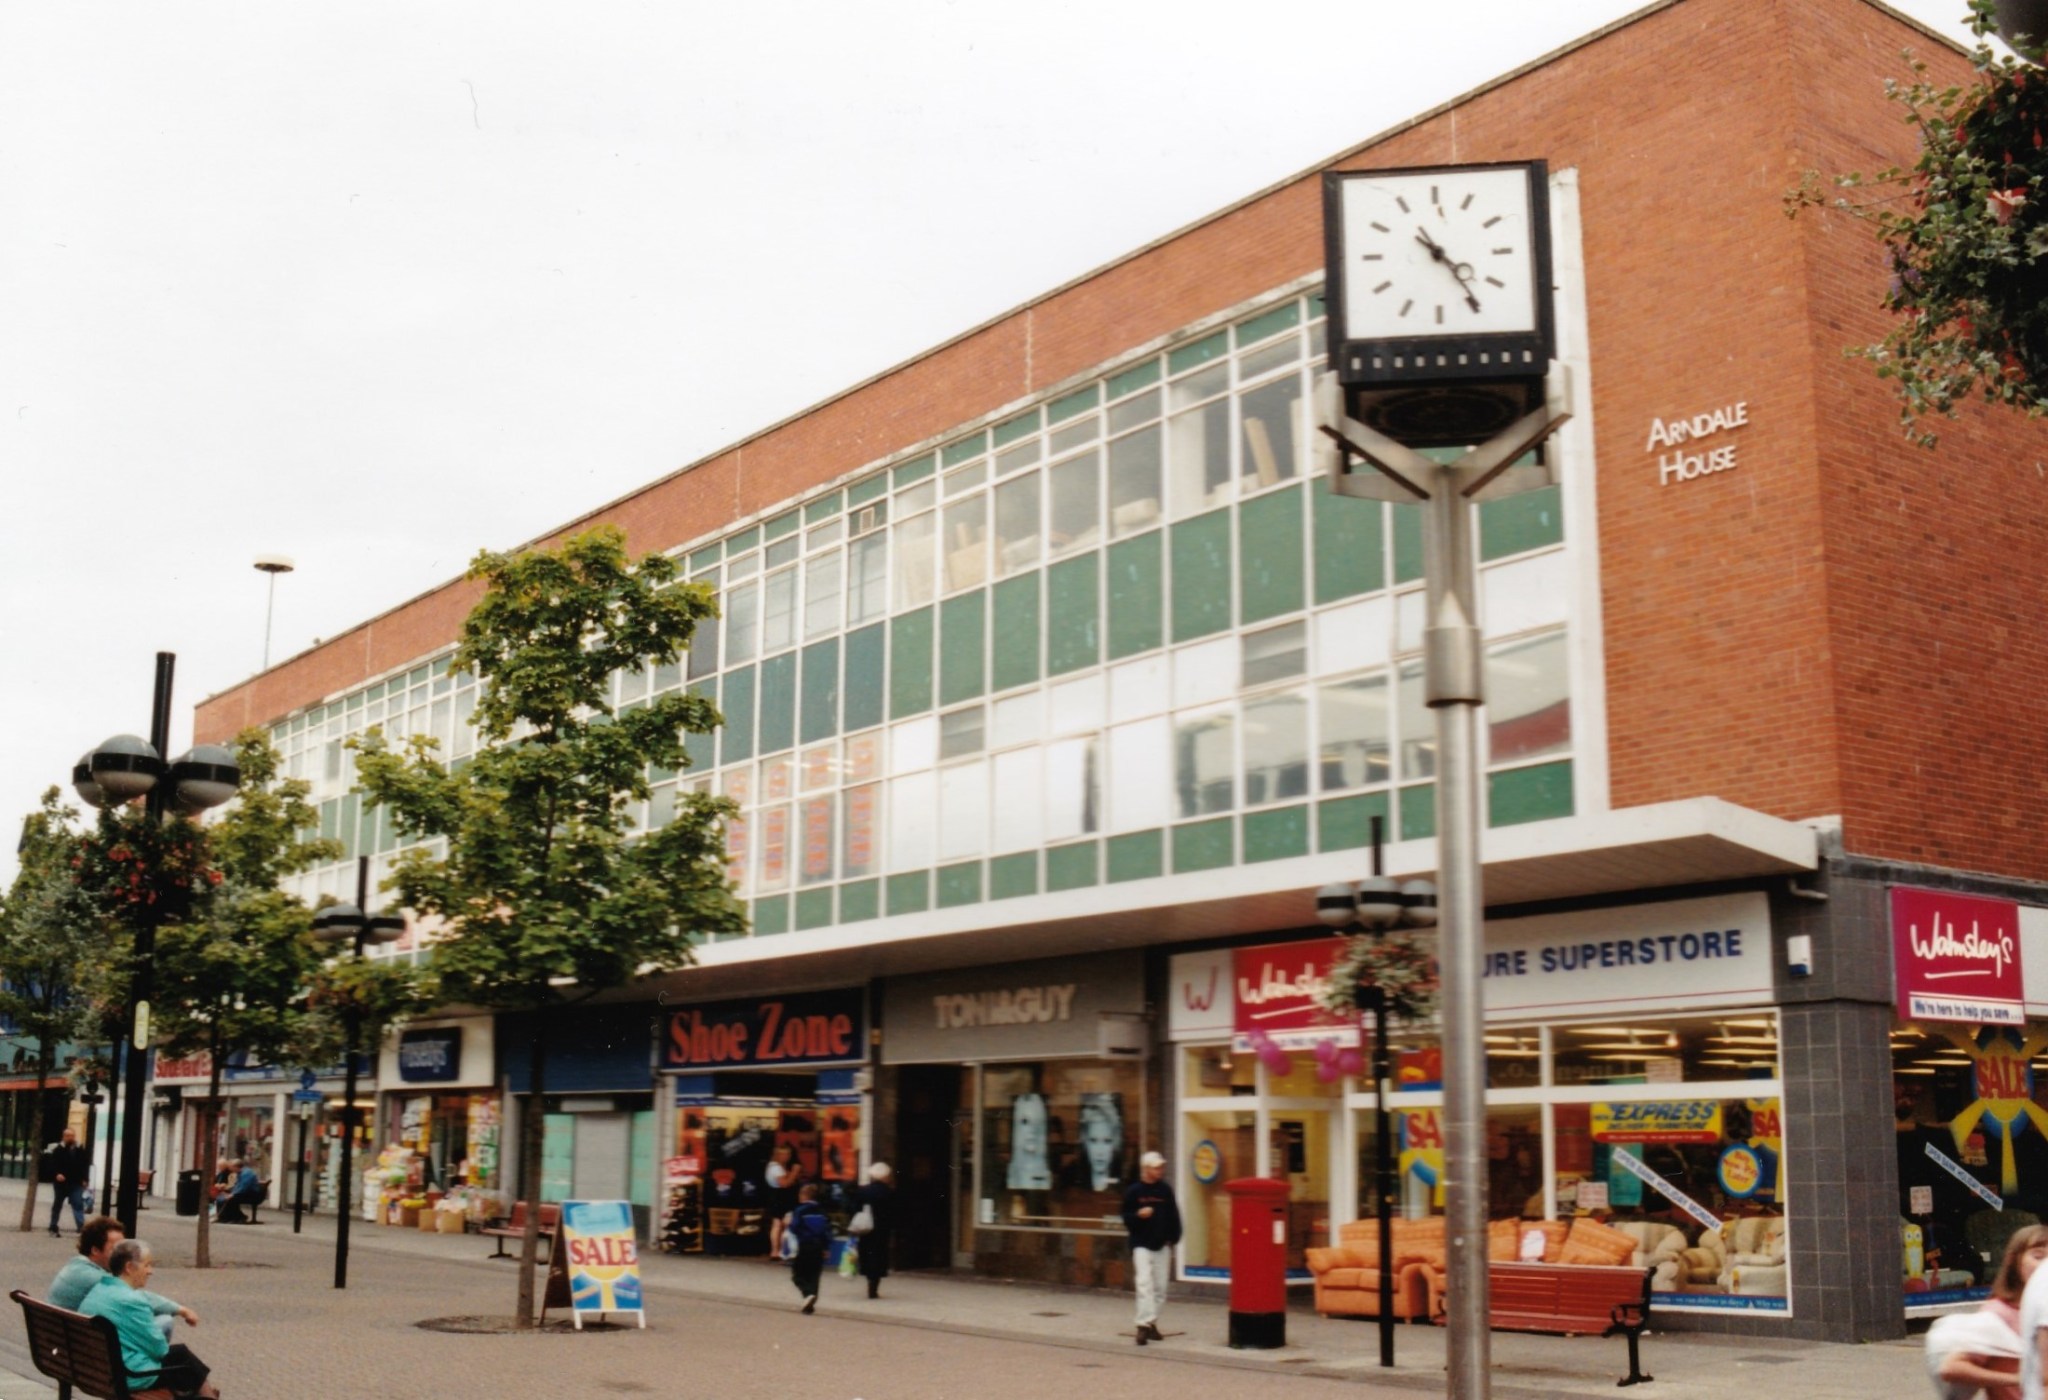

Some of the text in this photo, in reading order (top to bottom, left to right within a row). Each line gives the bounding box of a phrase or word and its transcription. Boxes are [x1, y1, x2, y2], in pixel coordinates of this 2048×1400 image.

[1660, 445, 1737, 486] HOUSE
[1541, 929, 1741, 973] SUPERSTORE
[1910, 911, 2013, 978] Walmsley's
[669, 1001, 854, 1063] Shoe Zone
[1976, 1055, 2030, 1100] SALE
[1406, 1109, 1445, 1149] SA
[1612, 1101, 1717, 1121] EXPRESS
[1752, 1109, 1782, 1138] SA
[569, 1236, 638, 1266] SALE
